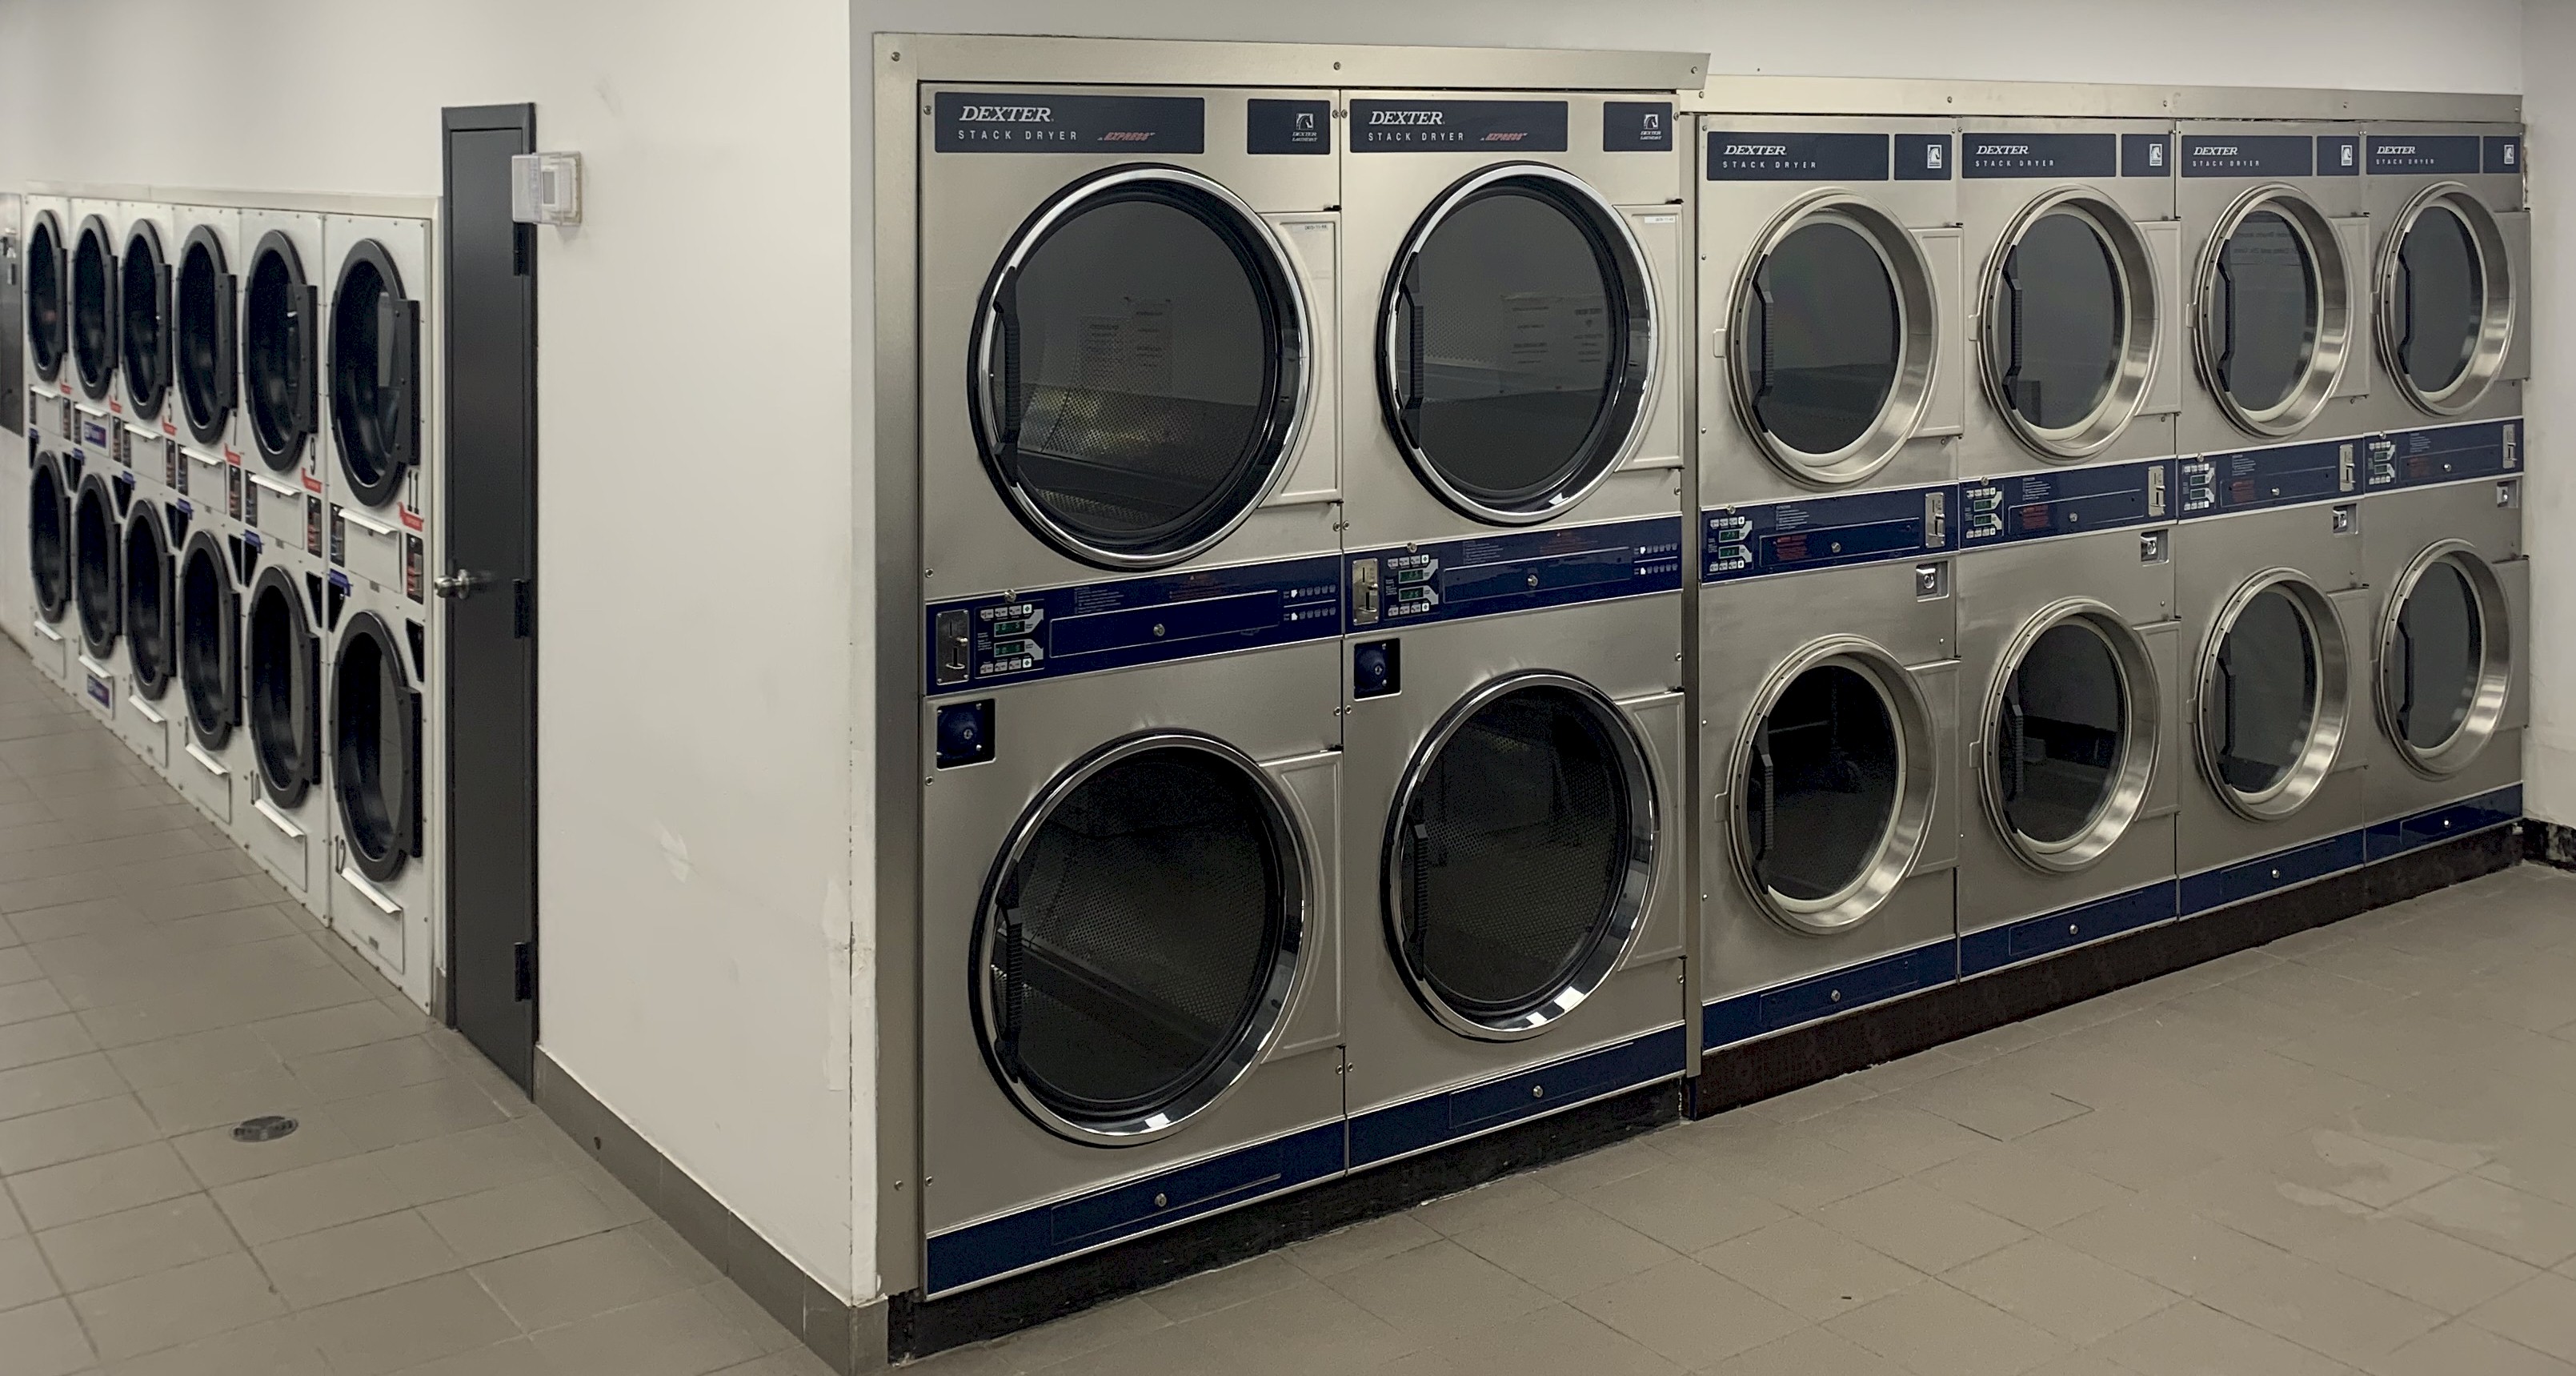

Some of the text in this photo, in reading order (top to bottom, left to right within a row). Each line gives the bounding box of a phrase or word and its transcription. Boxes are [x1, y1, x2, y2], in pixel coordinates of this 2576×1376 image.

[959, 106, 1052, 122] DEXTER
[1368, 110, 1443, 125] DEXTER
[958, 130, 1076, 140] STACK DRYER
[1368, 132, 1464, 142] STACK DRYER
[1724, 145, 1786, 155] DEXTER
[1976, 145, 2029, 154] DEXTER
[2193, 146, 2238, 155] DEXTER
[2376, 146, 2416, 154] DEXTER
[1722, 160, 1816, 169] STACK DRYER
[1975, 159, 2053, 167] STACK DRYER
